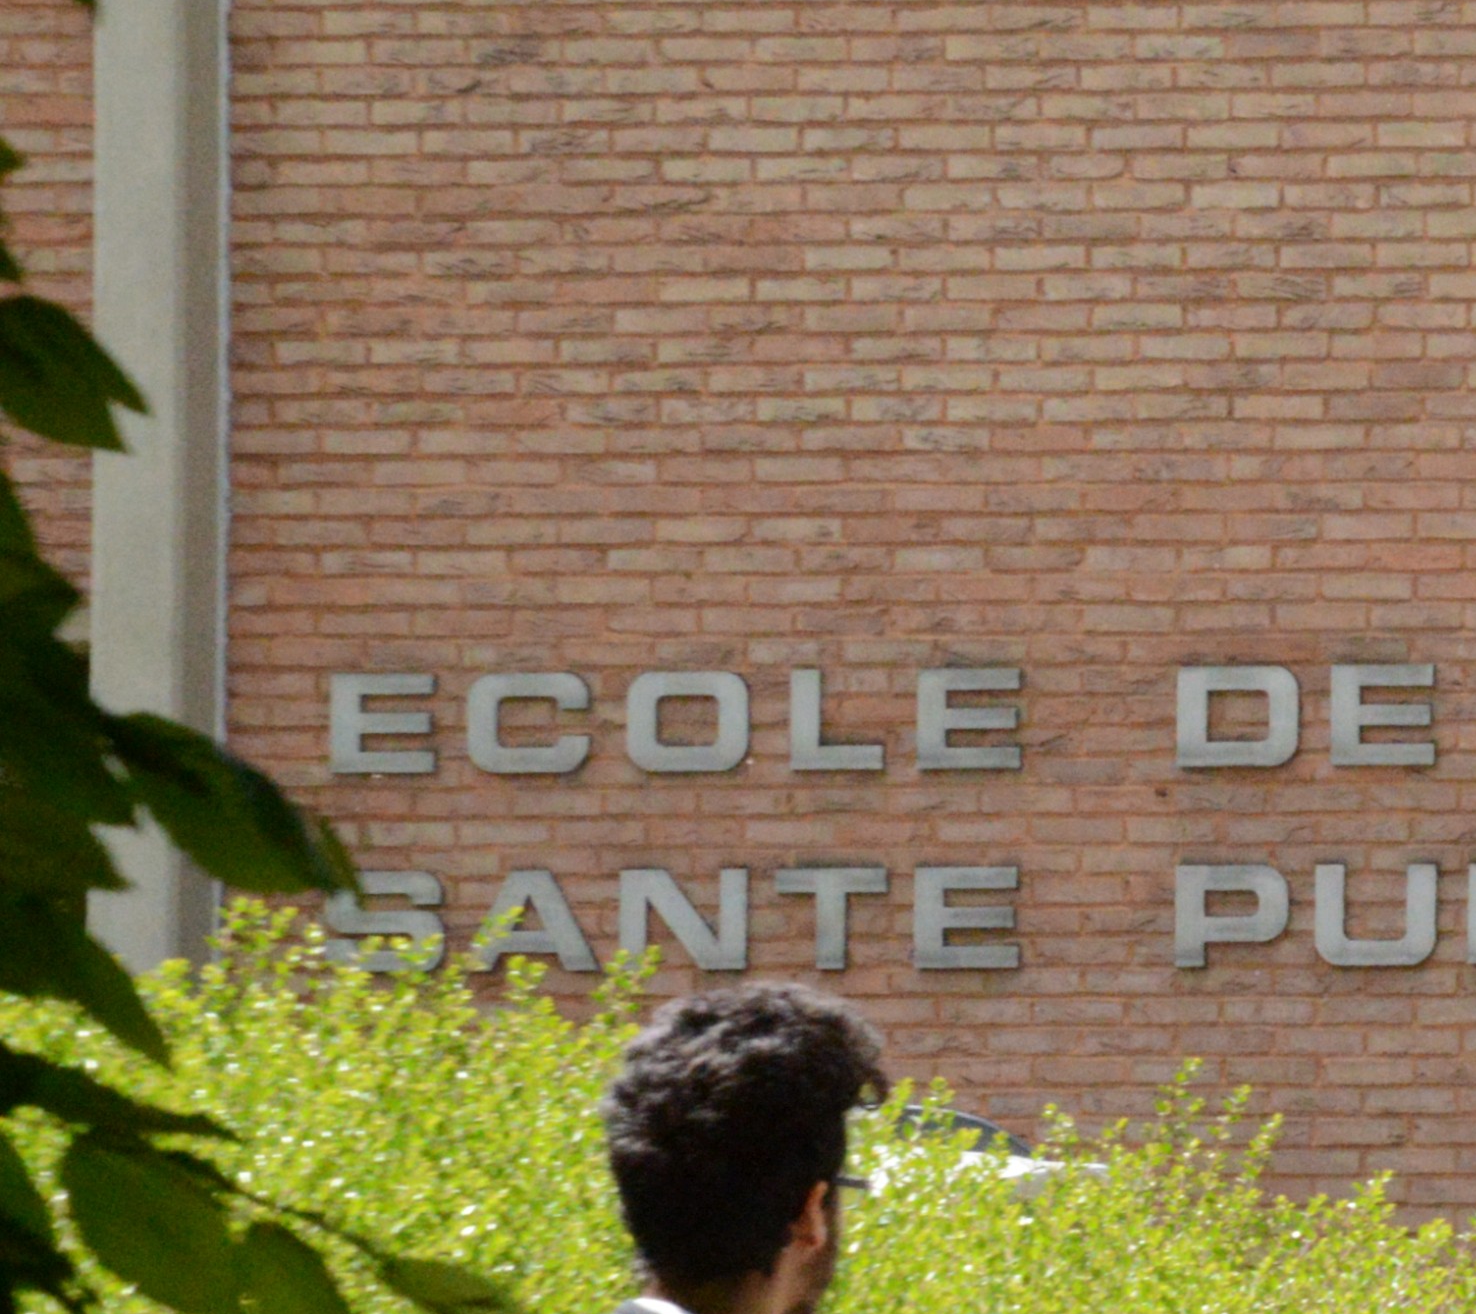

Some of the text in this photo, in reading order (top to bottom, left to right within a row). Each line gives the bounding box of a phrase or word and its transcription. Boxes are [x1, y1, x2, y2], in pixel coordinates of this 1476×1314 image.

[328, 663, 1436, 775] ECOLE DE
[324, 864, 1020, 973] SANTE
